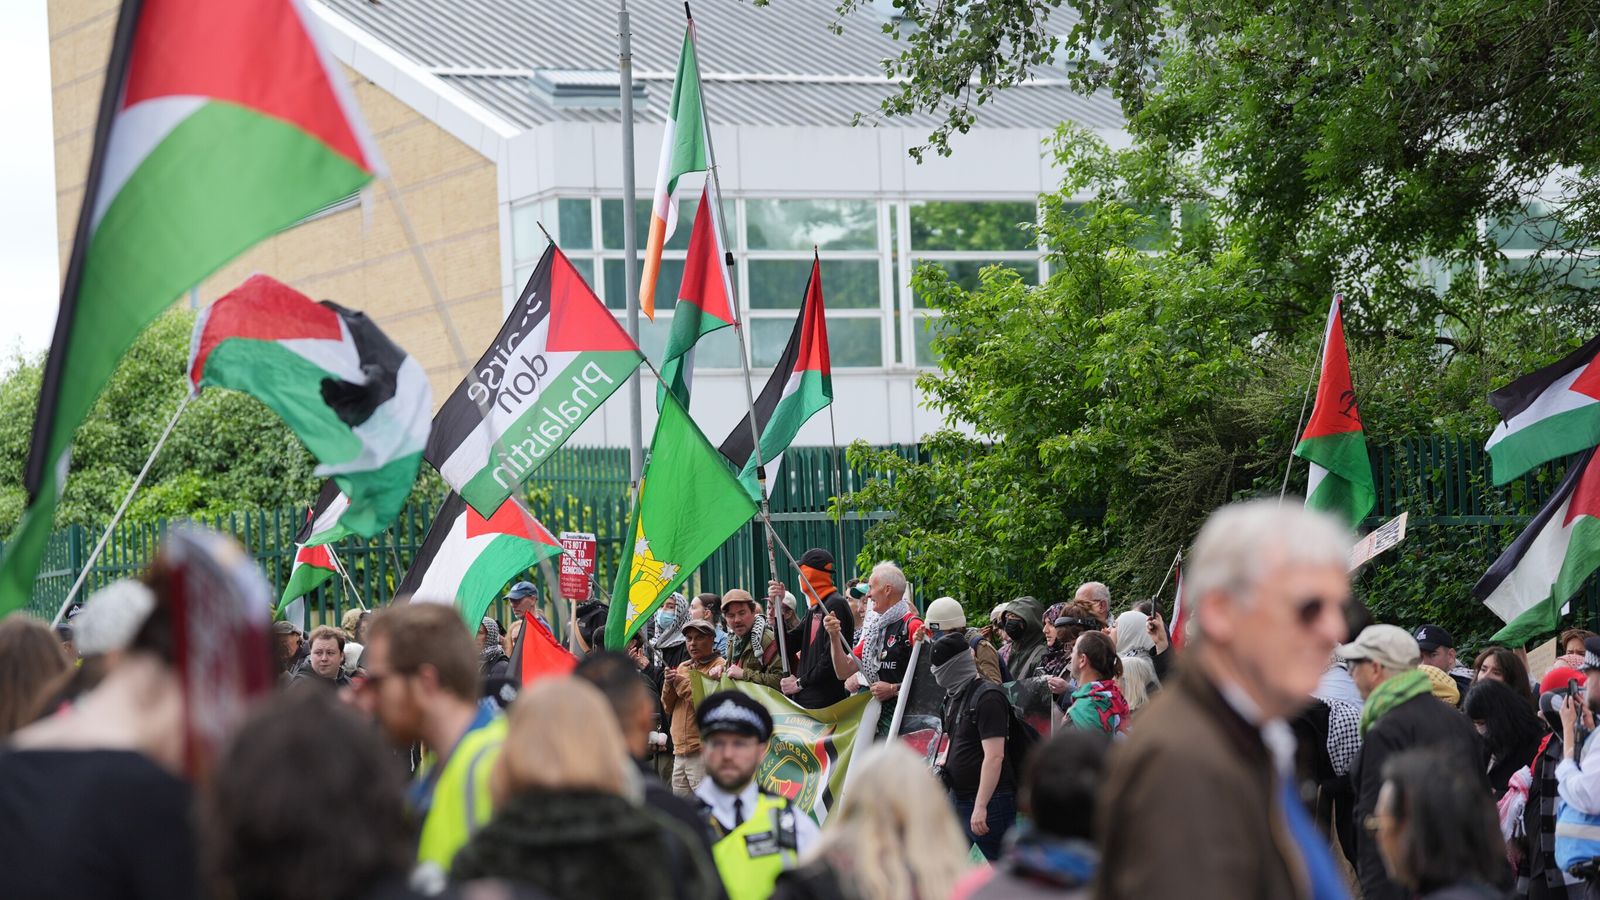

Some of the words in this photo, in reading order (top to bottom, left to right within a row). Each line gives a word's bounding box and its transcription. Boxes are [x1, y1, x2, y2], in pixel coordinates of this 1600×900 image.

[572, 541, 582, 550] NOT
[583, 542, 587, 550] A
[577, 550, 585, 558] TO
[562, 558, 571, 566] ACT
